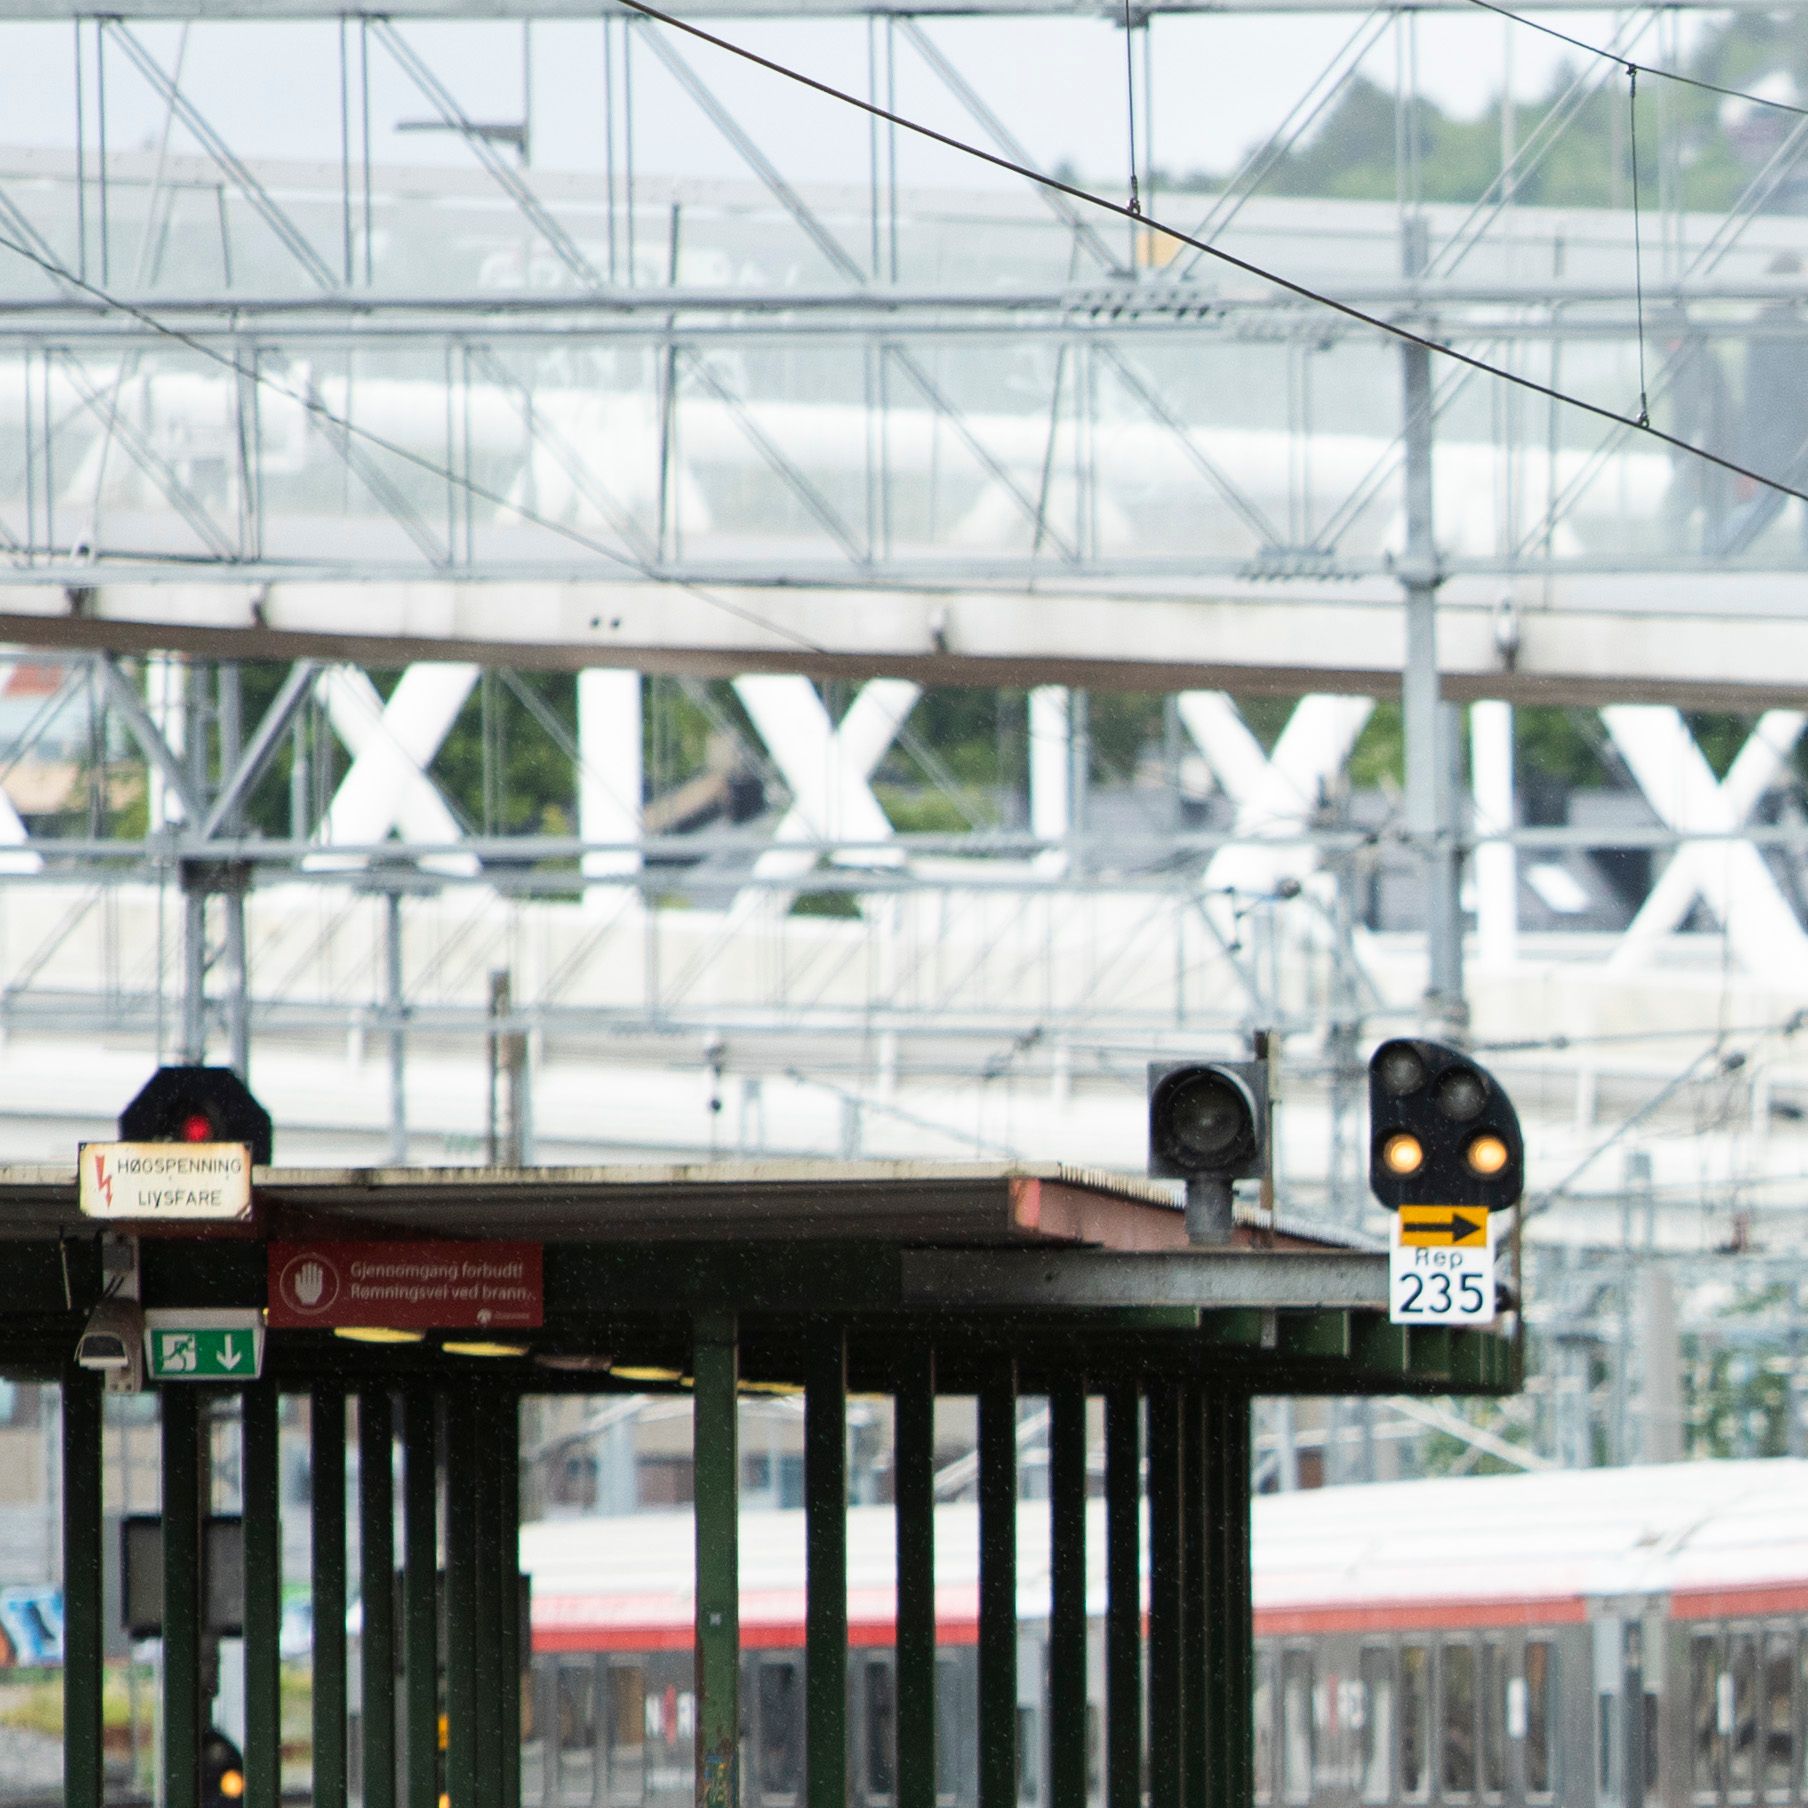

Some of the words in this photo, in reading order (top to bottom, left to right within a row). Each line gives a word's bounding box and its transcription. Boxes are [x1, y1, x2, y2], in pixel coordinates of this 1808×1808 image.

[117, 1158, 242, 1174] HØGSPENNING
[138, 1190, 222, 1209] LIVSFARE
[1415, 1247, 1463, 1270] Rep
[1400, 1272, 1484, 1313] 235
